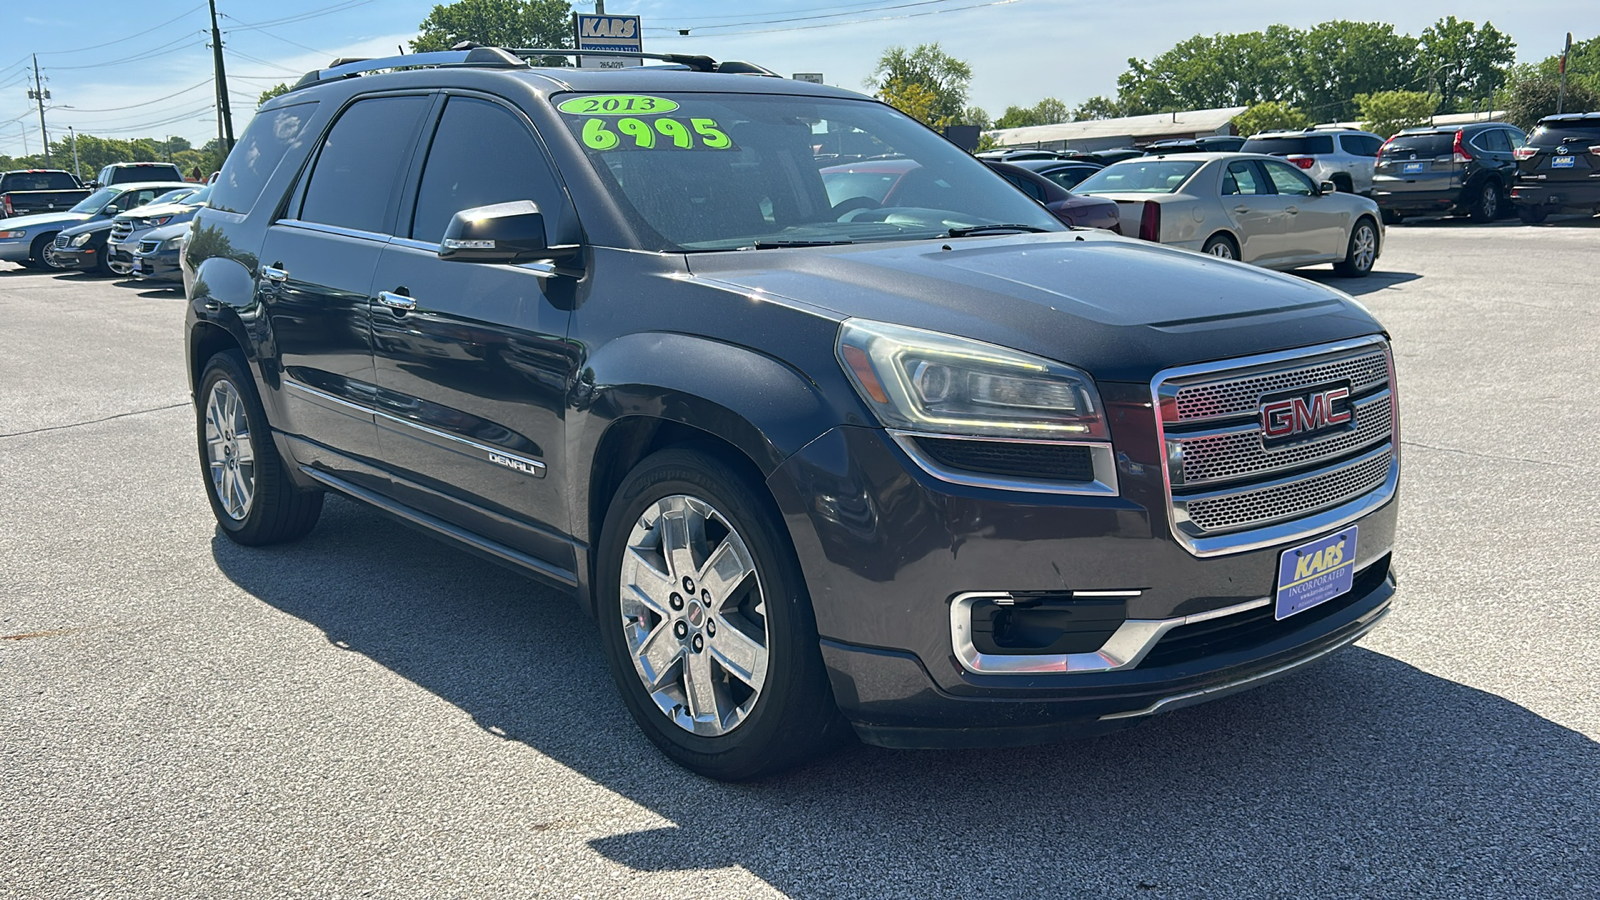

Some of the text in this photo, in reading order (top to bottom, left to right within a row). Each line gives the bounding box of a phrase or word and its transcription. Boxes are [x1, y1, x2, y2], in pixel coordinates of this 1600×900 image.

[582, 18, 635, 37] KARS
[583, 98, 655, 113] 2013
[582, 118, 732, 150] 6995
[1260, 387, 1351, 439] GMC
[489, 452, 535, 475] DENALI
[1294, 541, 1345, 581] KARS
[1288, 568, 1345, 597] INCORPORATED
